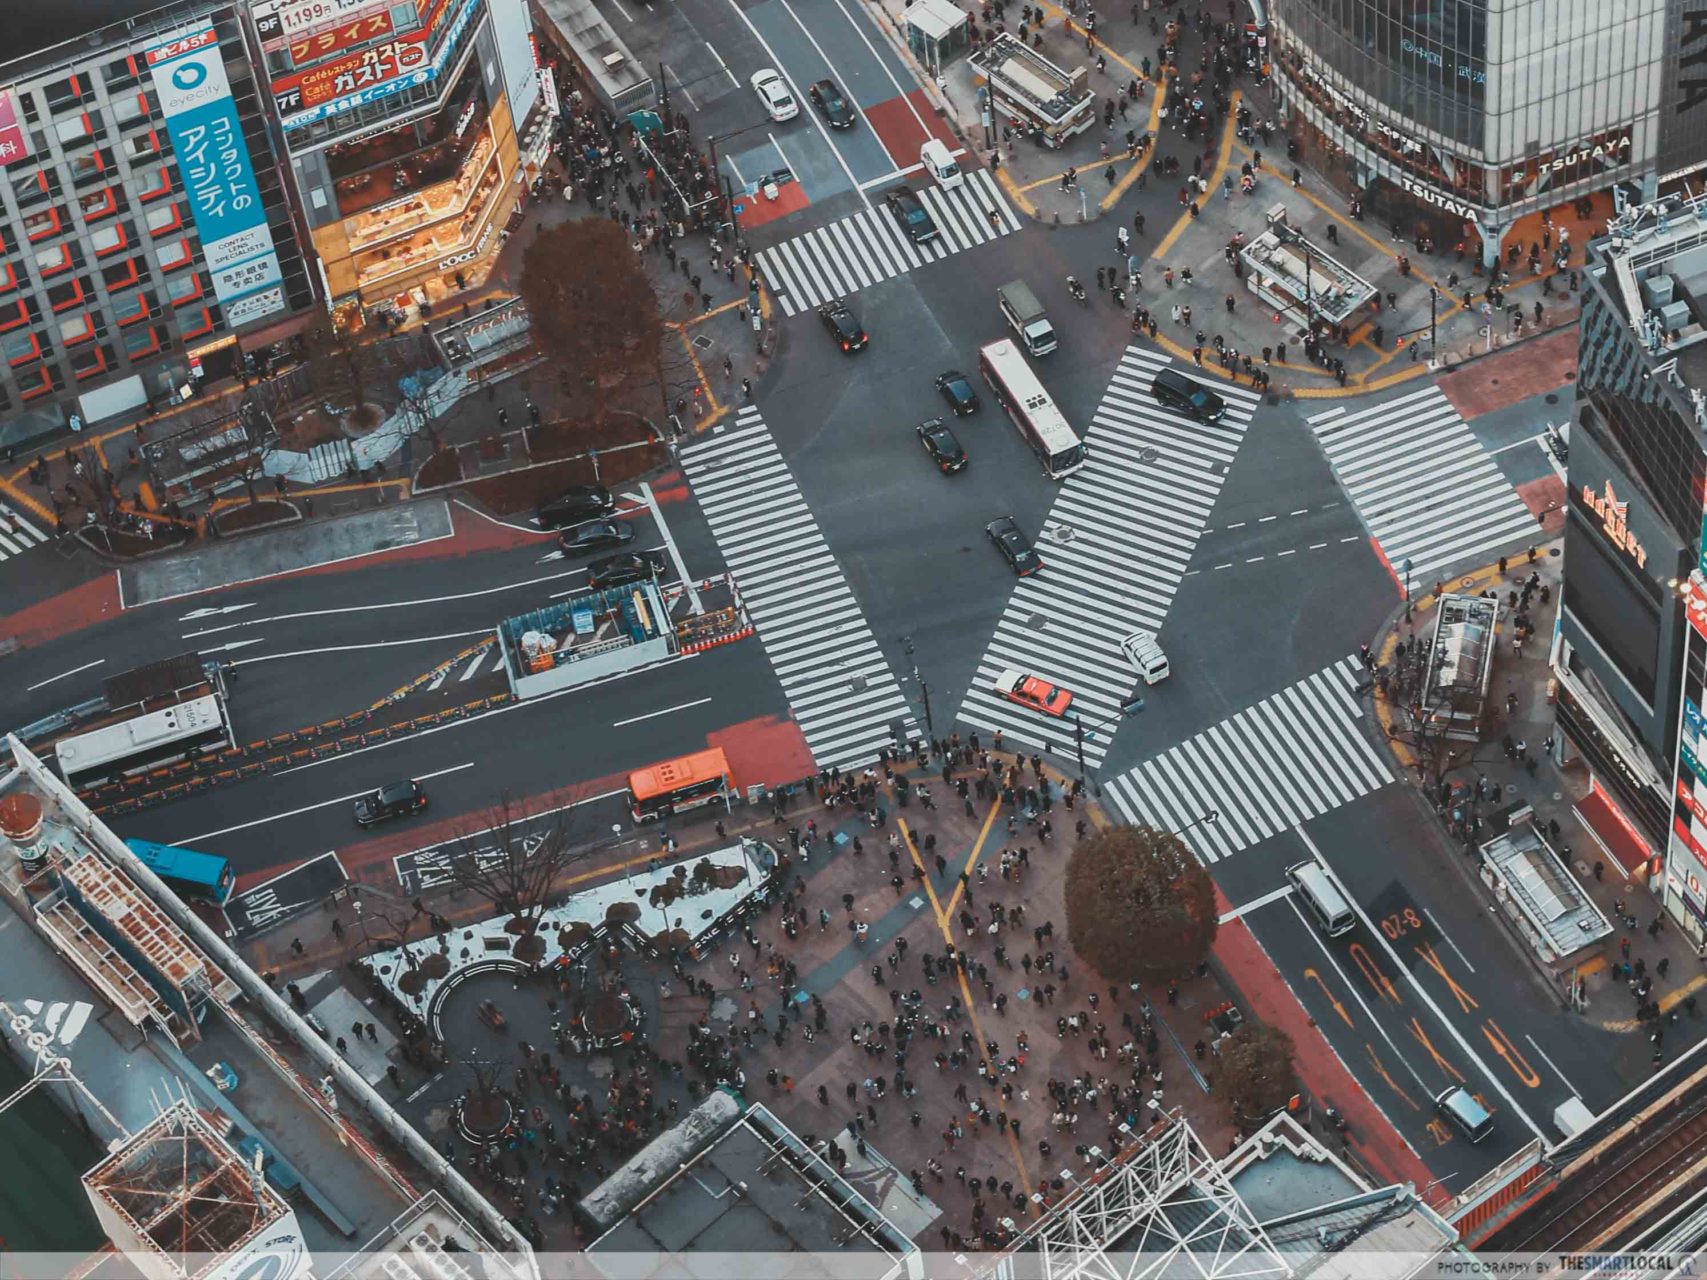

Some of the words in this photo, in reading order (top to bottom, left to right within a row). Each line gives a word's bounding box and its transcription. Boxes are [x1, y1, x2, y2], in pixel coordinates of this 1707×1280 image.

[258, 17, 278, 33] 9F
[362, 42, 408, 66] ガスト
[402, 51, 422, 65] ガスト
[334, 62, 392, 94] ガスト
[168, 83, 220, 109] eyecity
[277, 93, 301, 111] 7F
[211, 117, 252, 211] コンタクトの
[1539, 136, 1631, 175] TSUTAYA
[178, 125, 227, 219] アイシティ
[1401, 178, 1478, 222] TSUTAYA
[218, 232, 255, 250] CONTACT
[228, 242, 249, 253] LENS
[215, 242, 266, 265] SPECIALISTS
